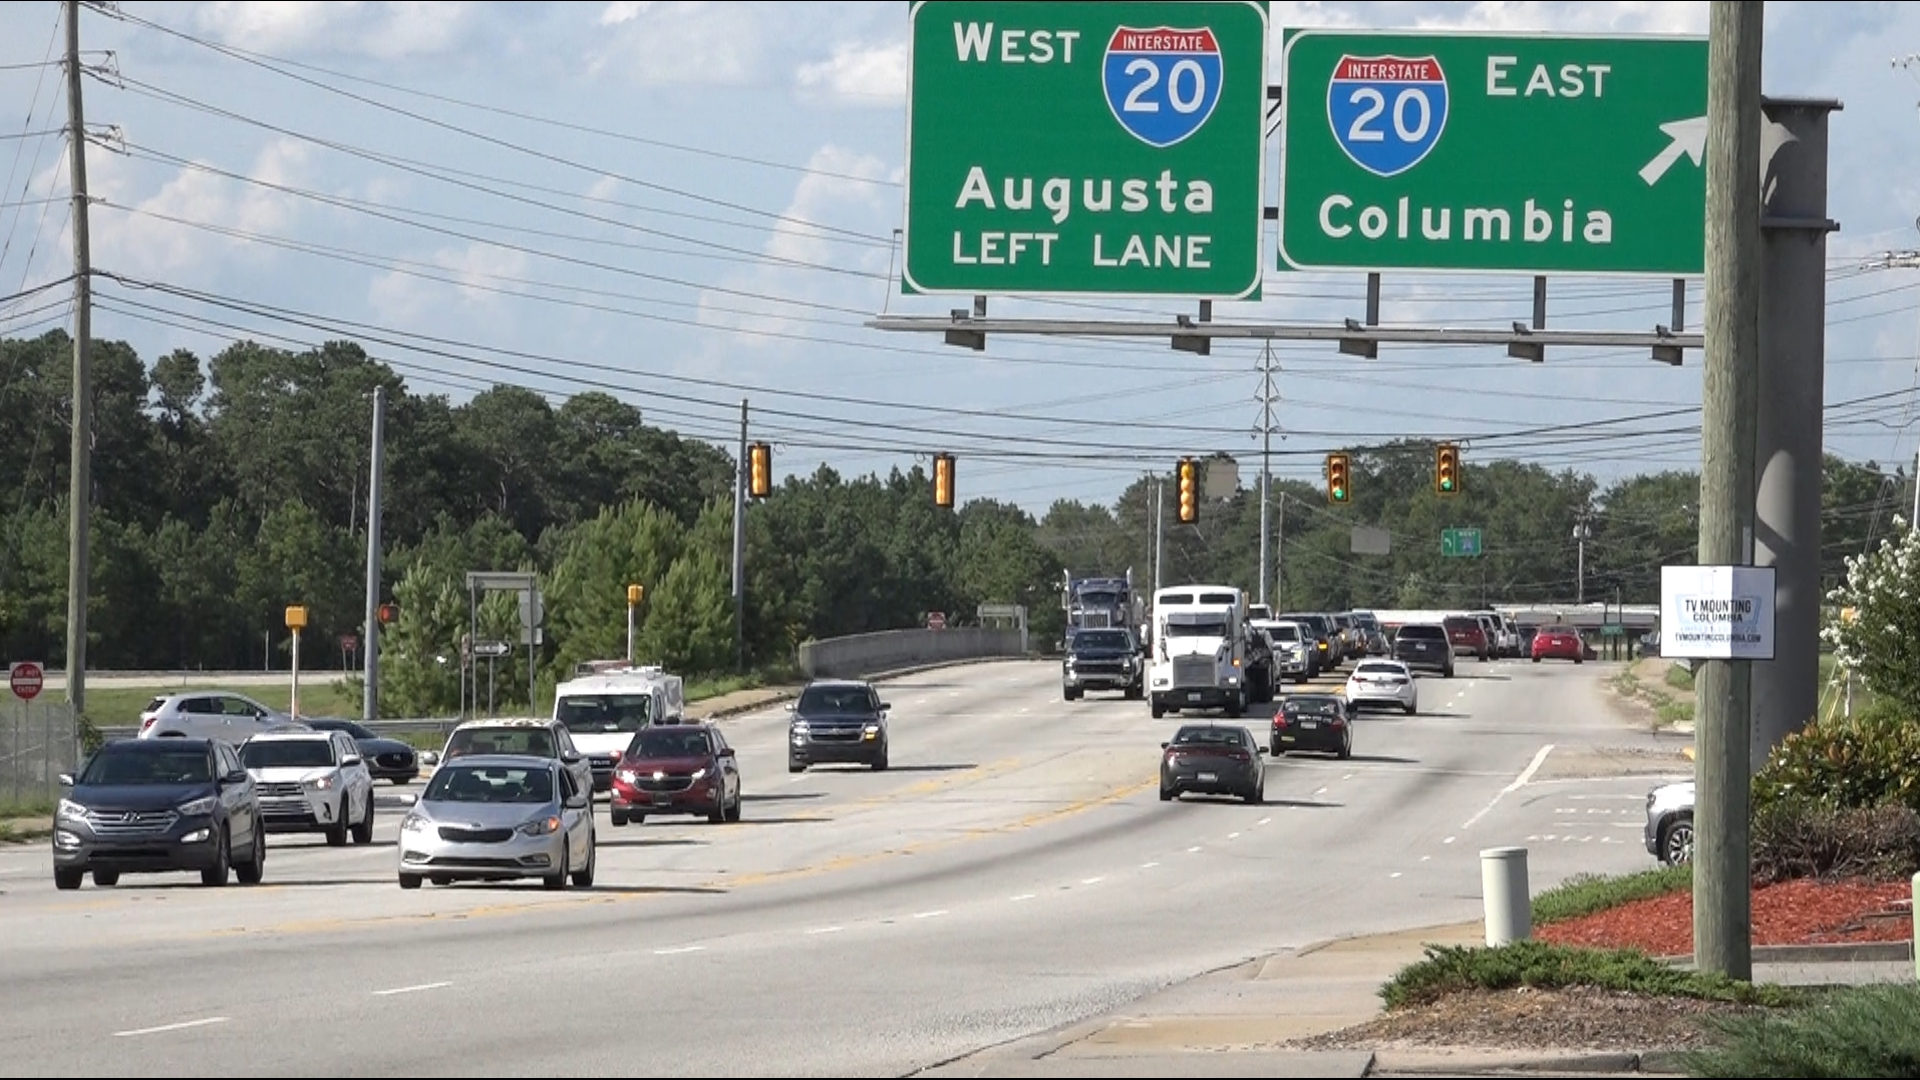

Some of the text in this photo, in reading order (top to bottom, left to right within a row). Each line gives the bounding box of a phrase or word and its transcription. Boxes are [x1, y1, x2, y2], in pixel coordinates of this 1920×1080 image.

[954, 22, 1080, 63] WEST
[1122, 35, 1204, 51] INTERSTATE
[1123, 58, 1206, 114] 20
[1347, 63, 1429, 80] INTERSTATE
[1486, 56, 1611, 97] EAST
[1348, 87, 1431, 143] 20
[955, 166, 1213, 225] Augusta
[1319, 194, 1612, 243] Columbia
[953, 231, 1211, 268] LEFT LANE
[1685, 600, 1751, 613] TV MOUNTING
[1693, 612, 1743, 622] COLUMBIA
